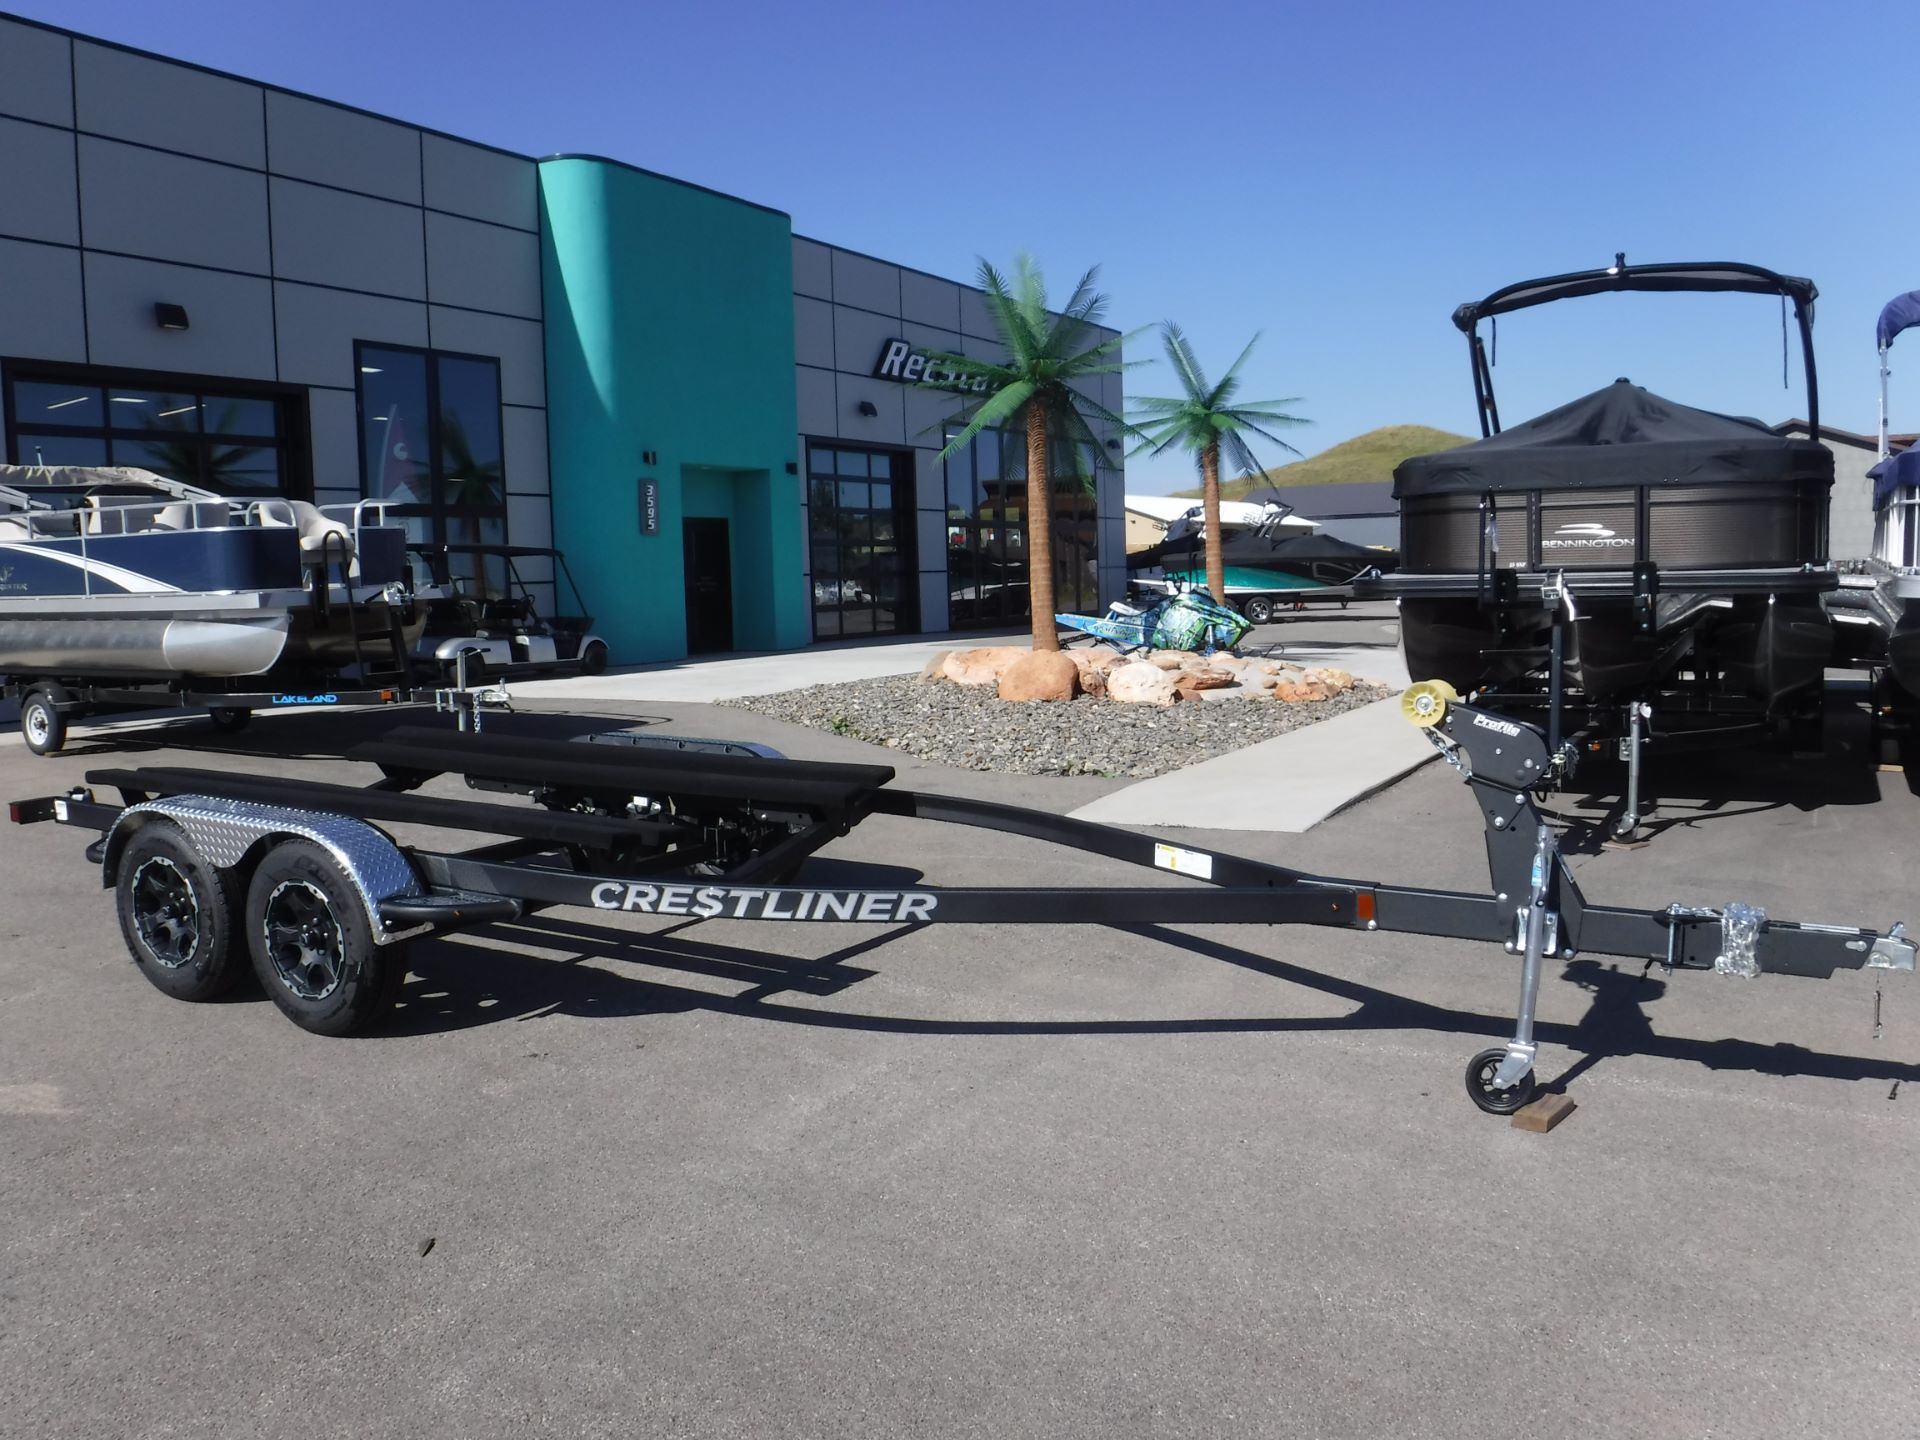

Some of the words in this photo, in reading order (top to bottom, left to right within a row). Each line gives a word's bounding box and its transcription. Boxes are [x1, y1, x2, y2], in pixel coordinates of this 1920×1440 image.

[646, 484, 655, 530] 3595
[1541, 538, 1635, 549] BENNINGTON
[272, 694, 338, 704] LAKELAND
[1474, 713, 1521, 735] Profile
[591, 882, 938, 921] CRESTLINER
